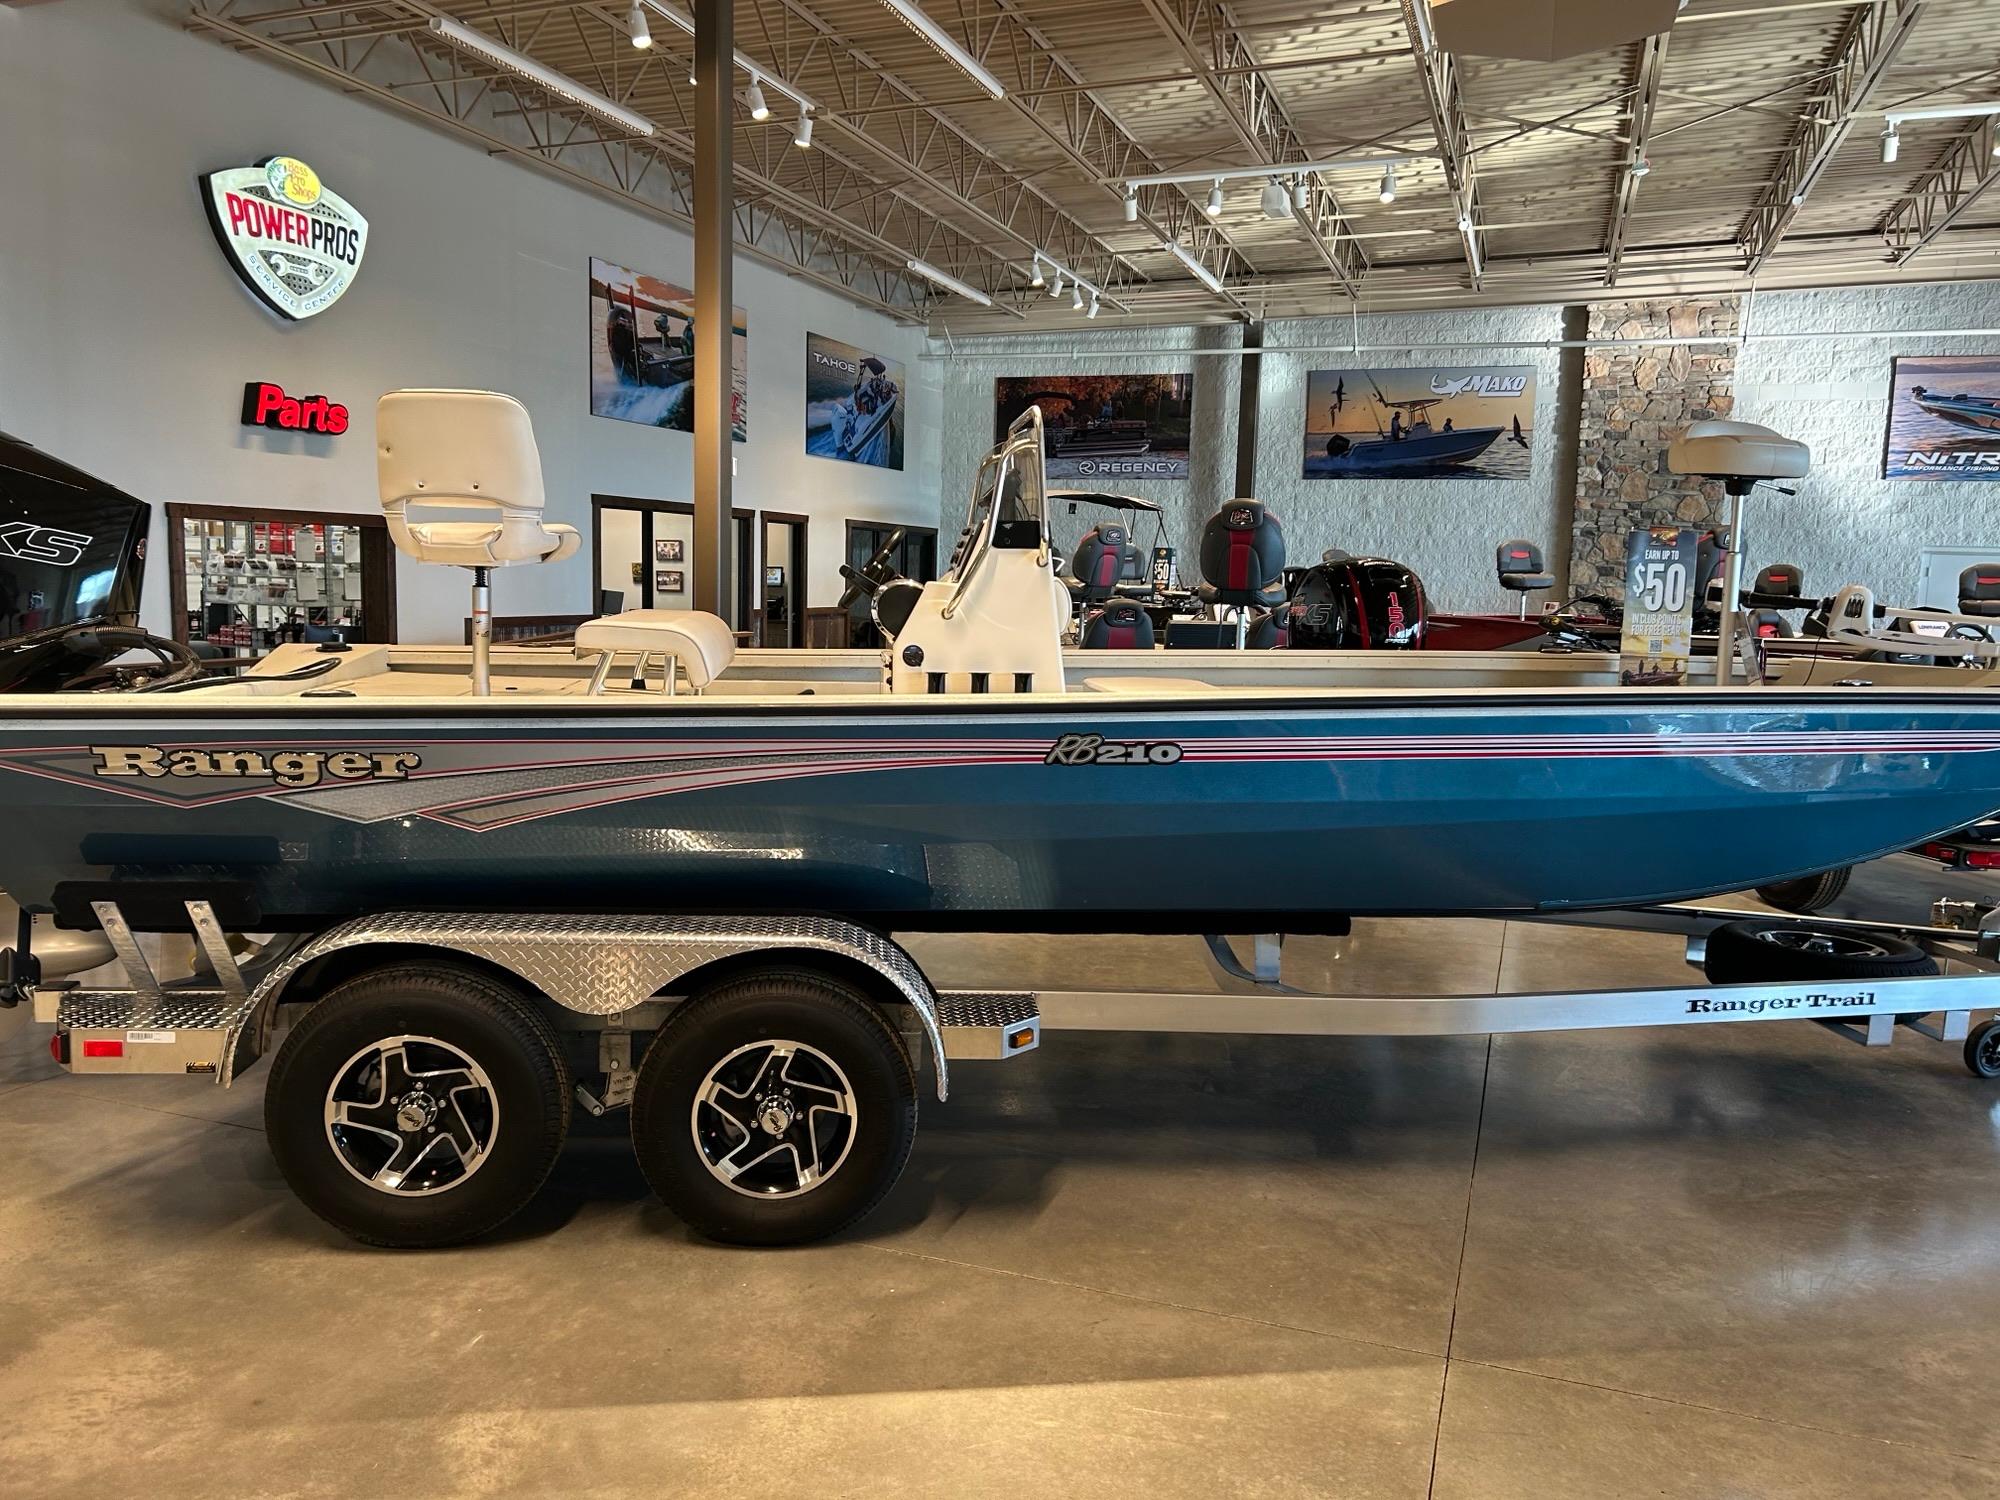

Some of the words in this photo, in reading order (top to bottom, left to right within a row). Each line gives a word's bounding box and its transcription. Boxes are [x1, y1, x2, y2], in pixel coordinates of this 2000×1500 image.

[288, 161, 308, 176] Bass
[290, 174, 305, 186] Pro
[292, 184, 317, 200] Shops
[249, 255, 297, 308] SERVICE
[304, 280, 345, 311] CENTER
[813, 352, 856, 374] TAHOE
[1465, 375, 1527, 396] MAKO
[256, 383, 348, 434] Parts
[1099, 462, 1179, 473] REGENCY
[1645, 549, 1661, 560] EARN
[1662, 550, 1670, 560] UP
[1671, 550, 1680, 560] TO
[1154, 563, 1169, 580] $50
[1632, 562, 1686, 612] $50
[1388, 591, 1405, 638] 150
[1632, 613, 1639, 624] IN
[1640, 613, 1656, 625] CLUB
[1657, 614, 1682, 625] POINTS
[1631, 624, 1645, 636] FOR
[1645, 625, 1662, 636] FREE
[89, 745, 421, 788] Ranger
[1685, 998, 1800, 1013] Ranger
[1806, 992, 1876, 1008] Trail
